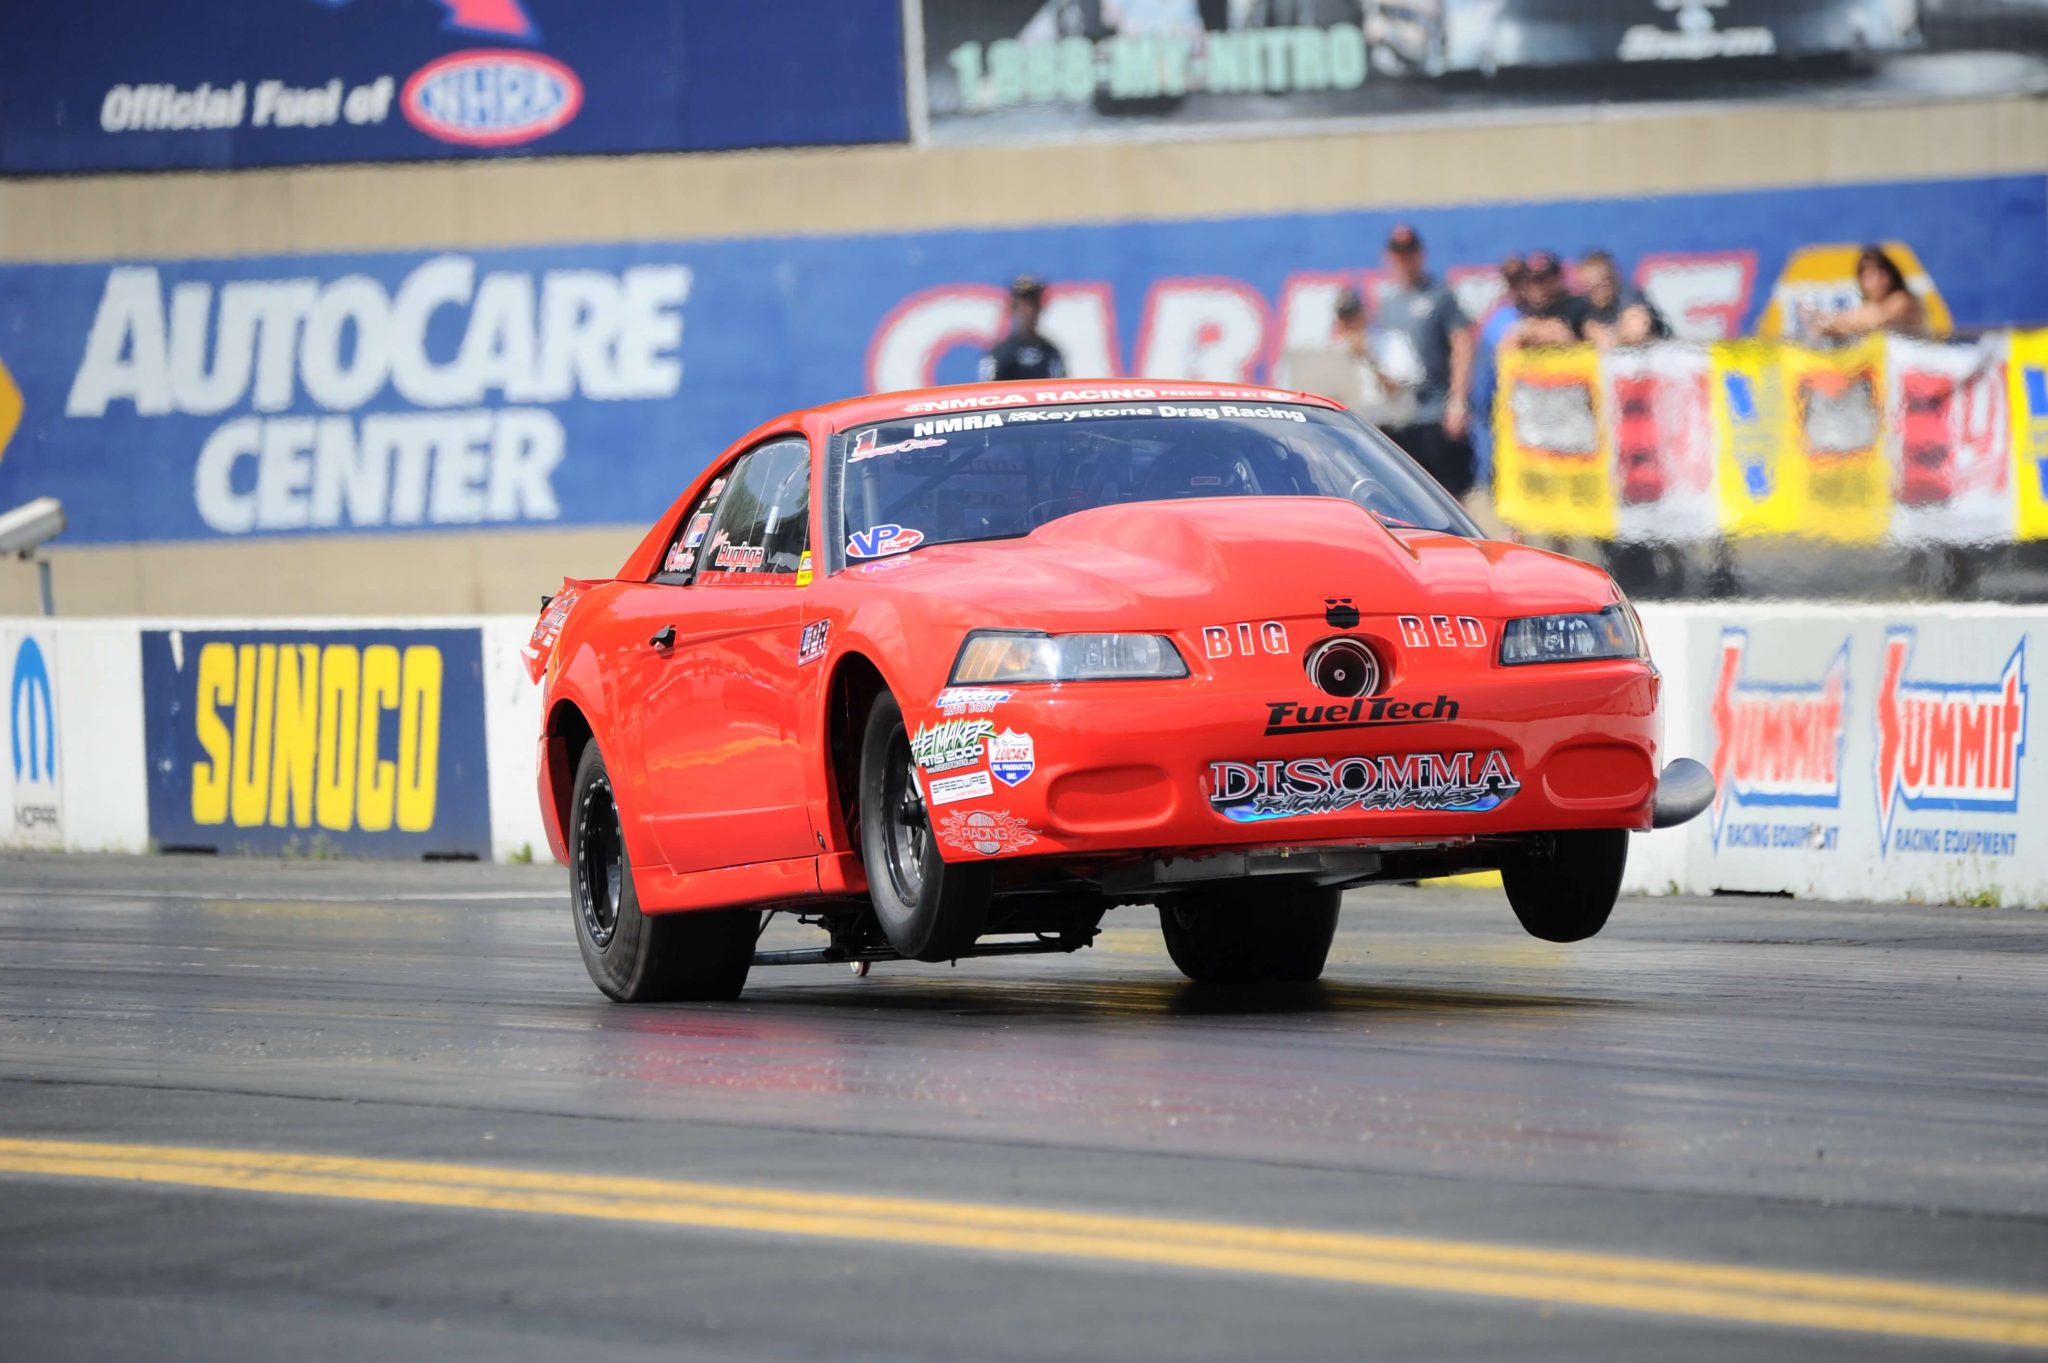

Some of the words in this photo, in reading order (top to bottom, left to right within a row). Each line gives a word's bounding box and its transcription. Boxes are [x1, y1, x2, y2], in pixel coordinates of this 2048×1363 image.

[100, 82, 247, 133] Official
[251, 77, 344, 128] Fuel
[344, 75, 396, 126] of
[420, 63, 564, 130] NHRA
[923, 394, 1029, 412] NMCA
[1036, 388, 1156, 402] RACING
[1034, 406, 1153, 422] Keystone
[1157, 405, 1220, 420] Drag
[1220, 405, 1307, 423] Racing
[914, 413, 1004, 438] NMRA
[194, 407, 566, 533] CENTER
[849, 524, 901, 557] VP
[1203, 621, 1289, 659] BIG
[1398, 615, 1488, 648] RED
[943, 703, 967, 717] AUTO
[968, 701, 996, 713] BODY
[1265, 695, 1460, 726] FuelTech
[192, 642, 443, 832] SUNOCO
[1712, 645, 1843, 815] SUMMIT
[1878, 642, 2020, 818] SUMMIT
[946, 744, 985, 762] 2000
[995, 747, 1029, 761] LUCAS
[1001, 763, 1032, 771] PRODUCTS
[1210, 749, 1521, 801] DISOMMA
[1252, 789, 1362, 815] RACING
[1361, 783, 1485, 812] ENGINES
[961, 827, 1008, 841] RACING
[1727, 824, 1768, 848] RACING
[1896, 829, 1941, 850] RACING
[1945, 830, 2017, 855] EQUIPMENT
